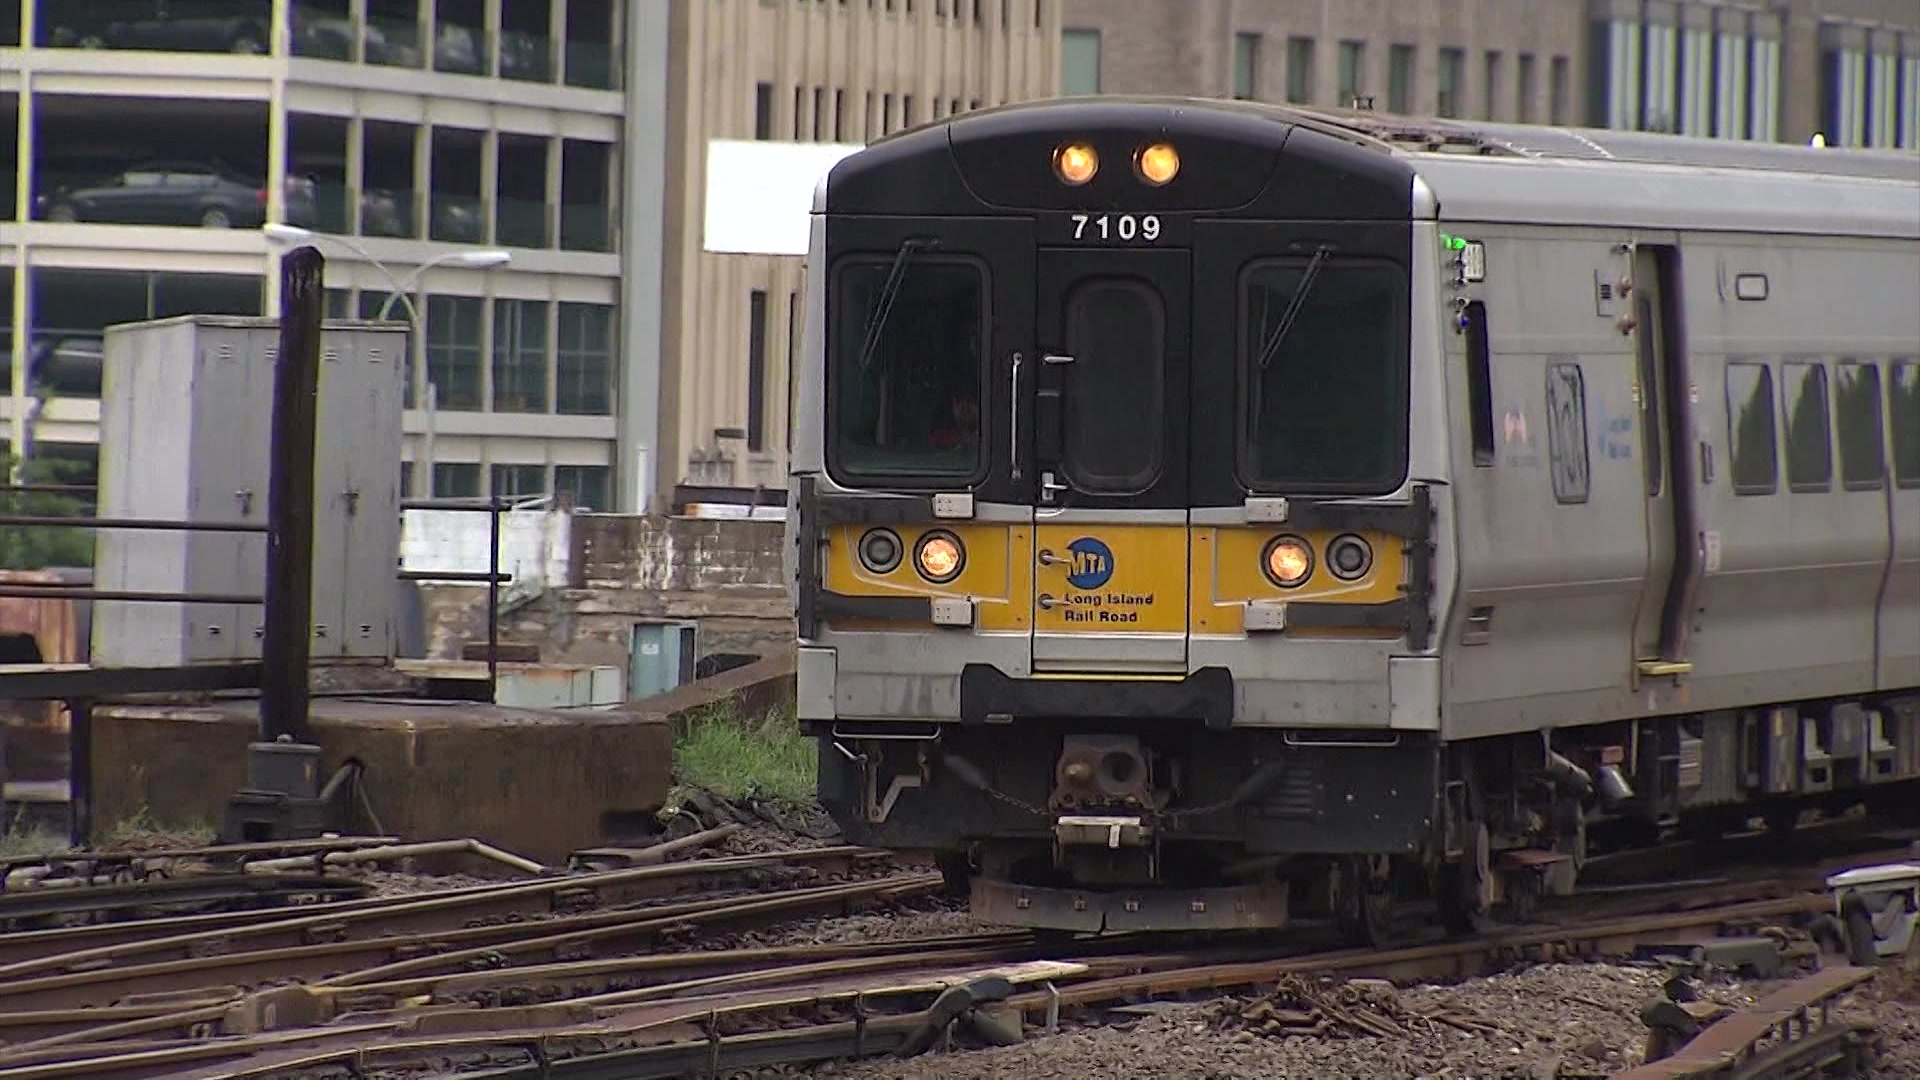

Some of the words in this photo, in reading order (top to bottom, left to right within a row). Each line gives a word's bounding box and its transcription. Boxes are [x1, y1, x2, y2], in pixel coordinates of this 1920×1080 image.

[1071, 214, 1161, 240] 7109
[1067, 550, 1106, 578] MTA
[1065, 592, 1102, 606] Long
[1107, 592, 1154, 605] Island
[1064, 609, 1094, 622] Rail
[1099, 610, 1138, 622] Road
